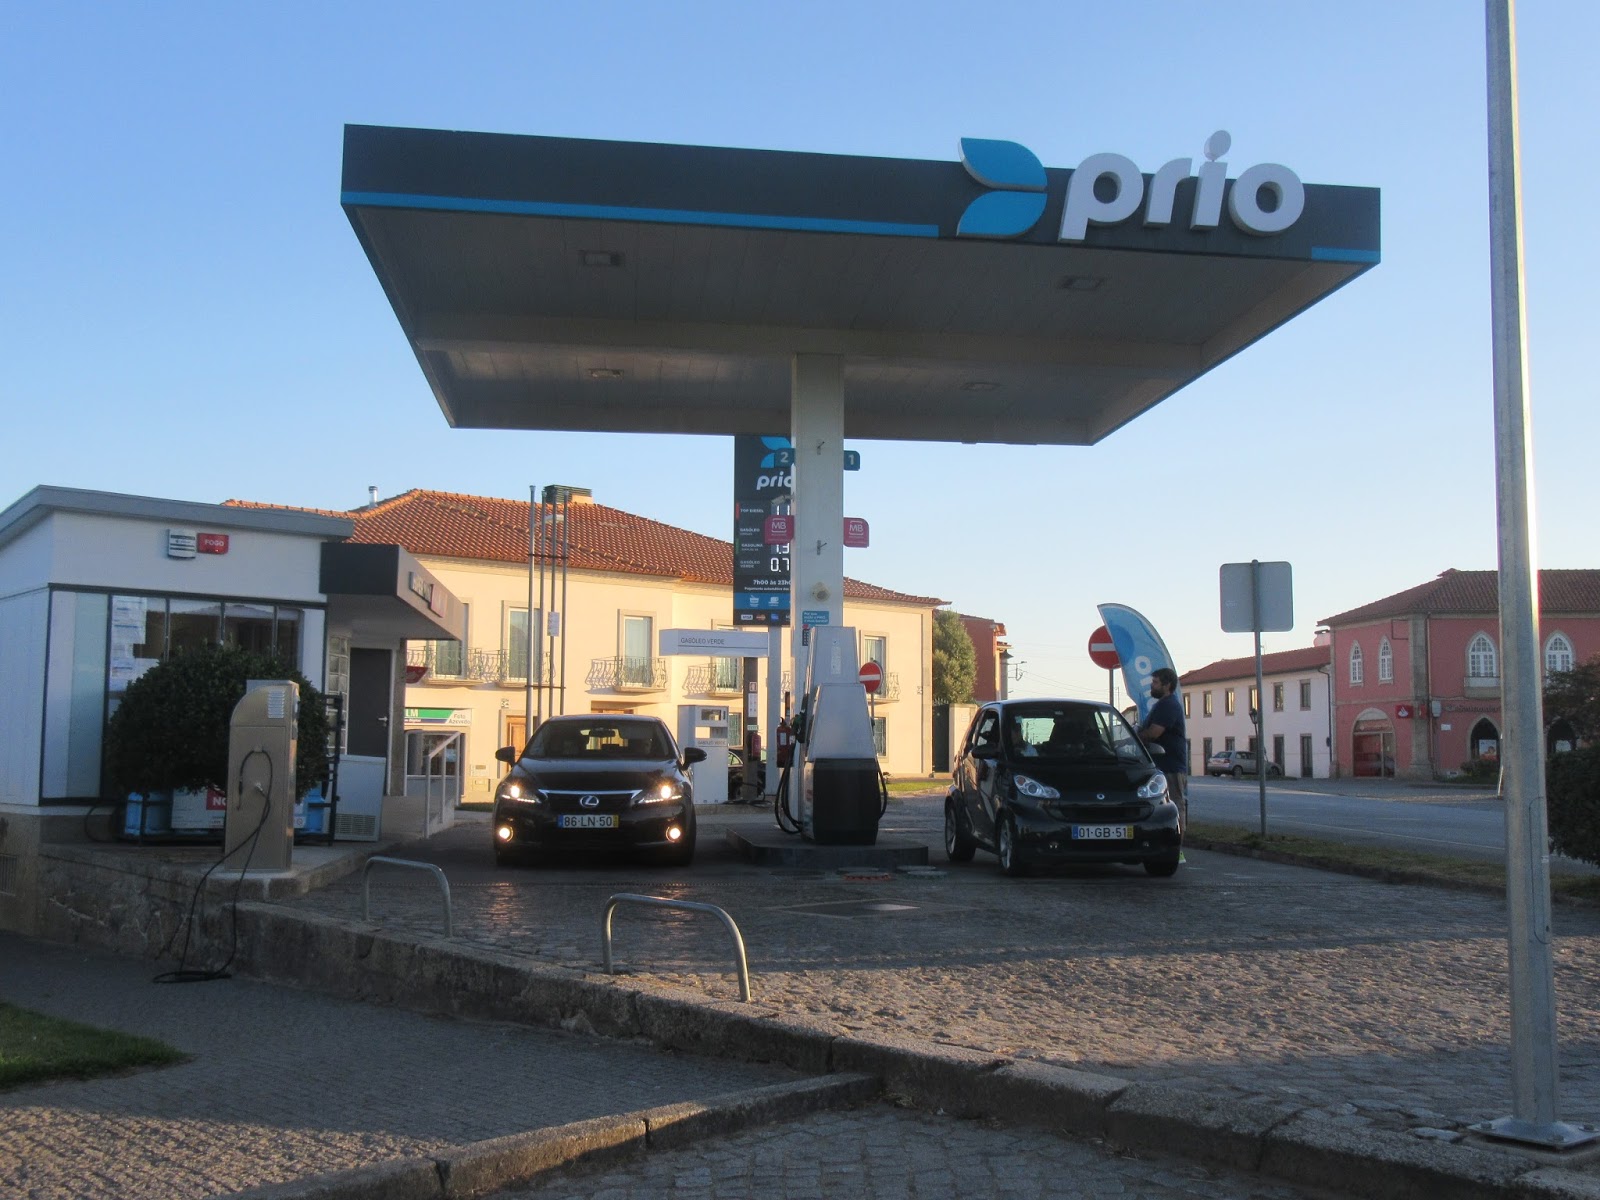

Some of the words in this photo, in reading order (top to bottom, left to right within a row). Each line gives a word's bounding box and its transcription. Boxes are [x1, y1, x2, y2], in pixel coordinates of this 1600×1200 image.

[1058, 130, 1305, 244] prio
[780, 452, 789, 463] 2
[848, 454, 855, 466] 1
[771, 522, 786, 530] MB
[849, 524, 864, 532] MB
[681, 637, 706, 645] GASÓLEO
